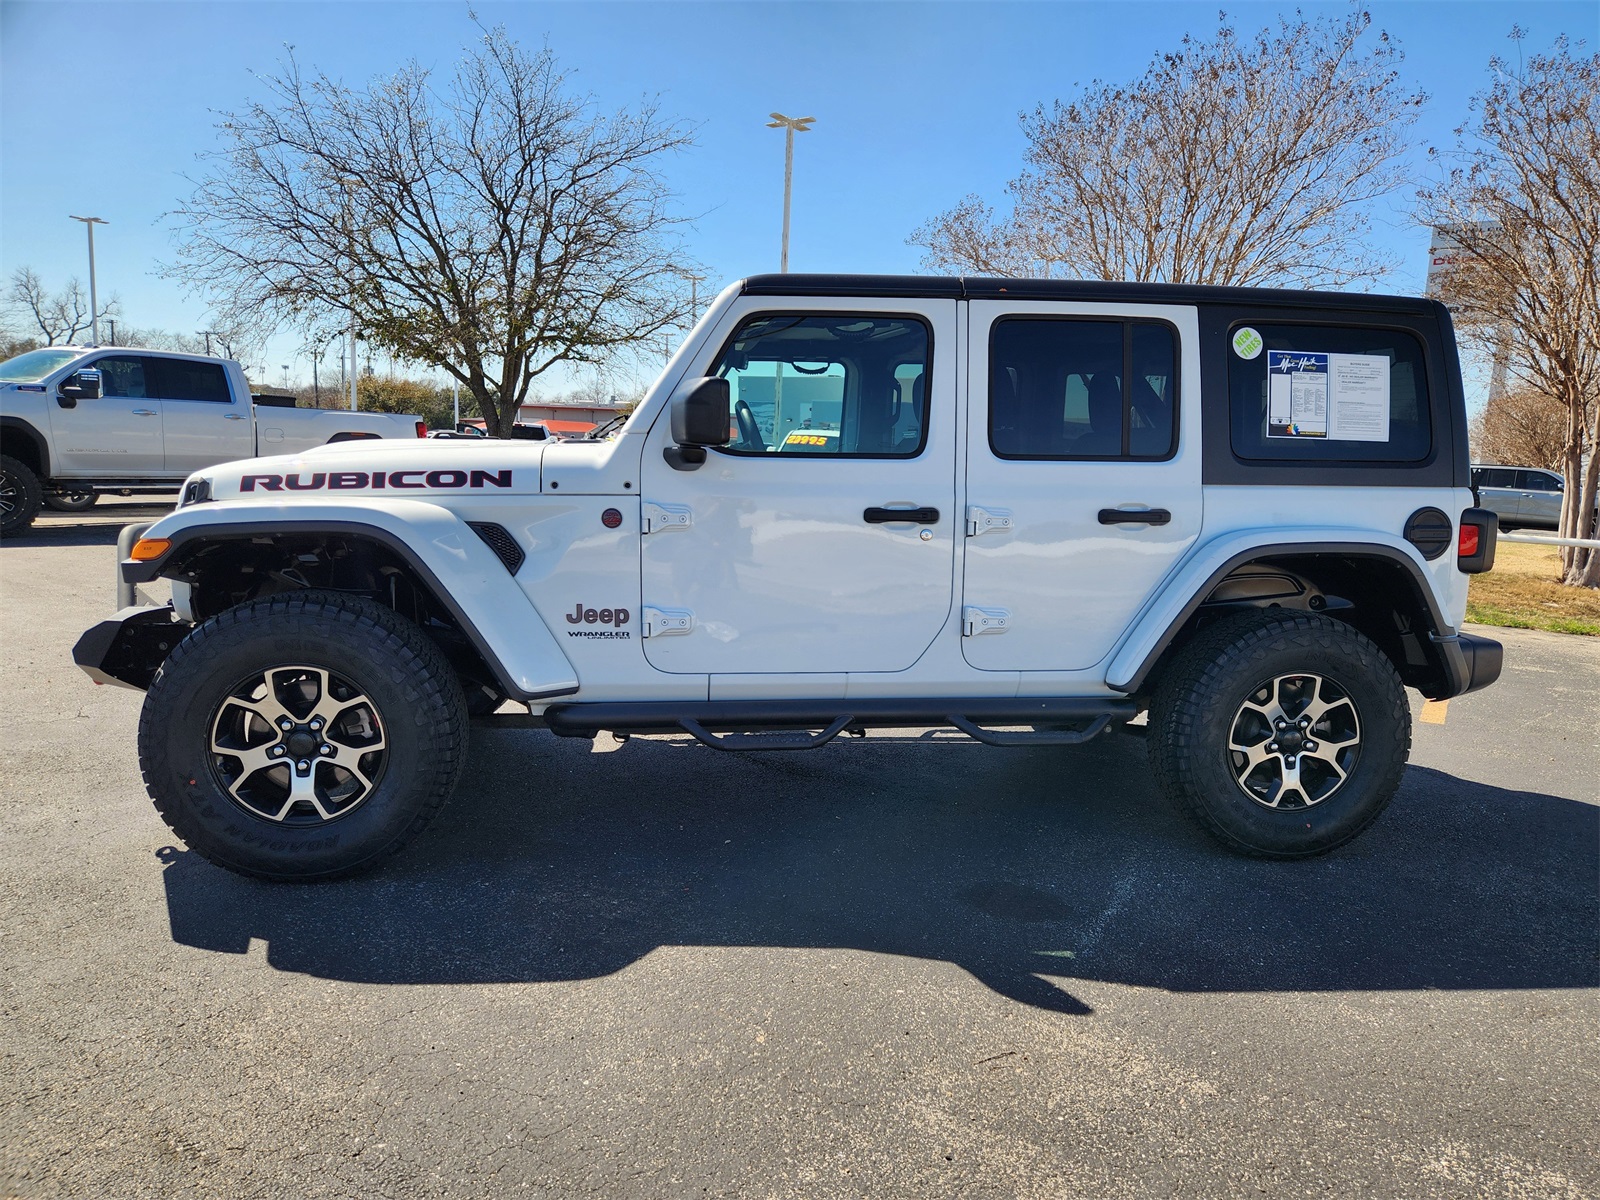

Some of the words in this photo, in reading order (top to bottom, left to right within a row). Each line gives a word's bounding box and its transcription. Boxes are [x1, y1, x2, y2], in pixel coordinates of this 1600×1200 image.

[1234, 329, 1252, 348] NEW
[1240, 336, 1262, 358] TIRES
[240, 469, 513, 493] RUBICON
[566, 603, 630, 628] Jeep
